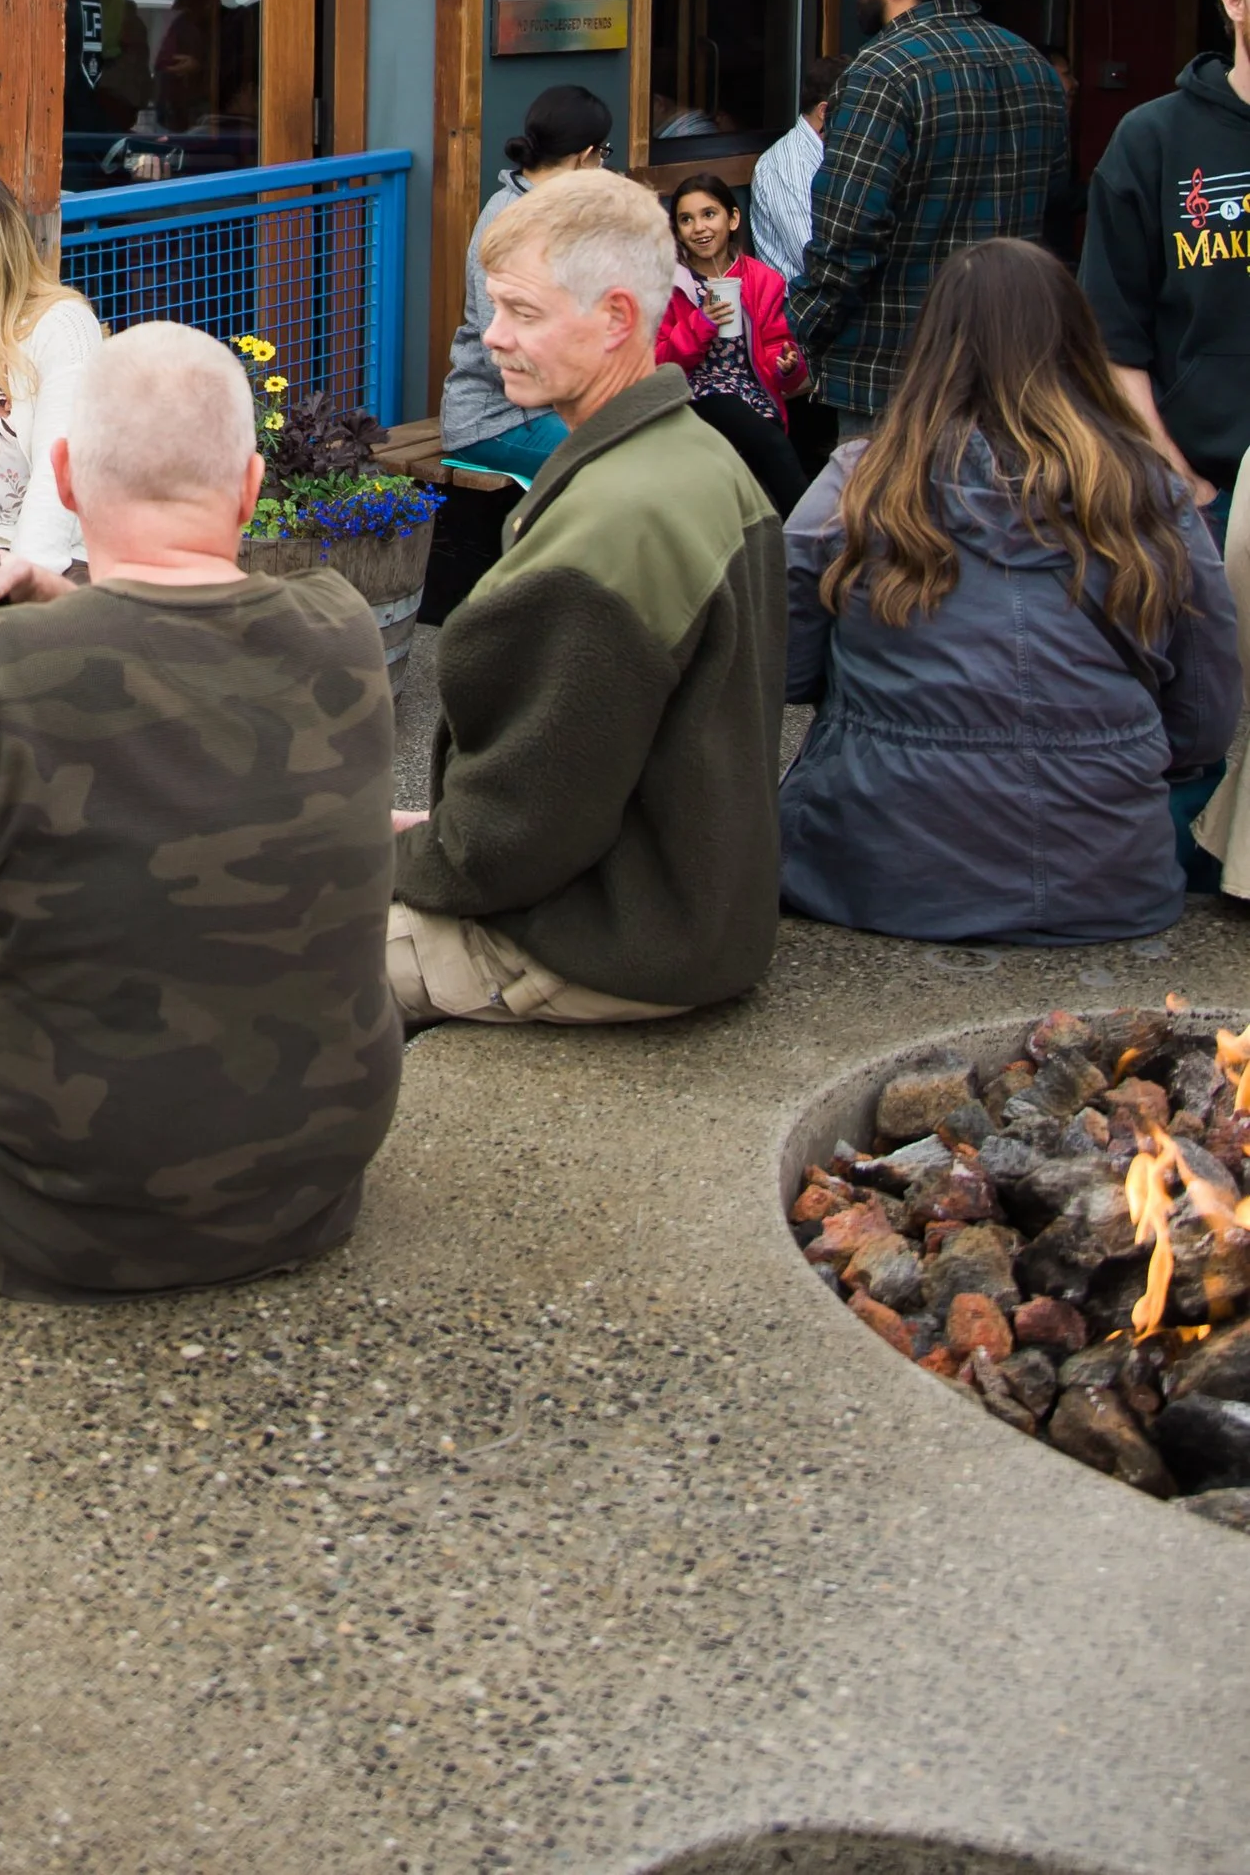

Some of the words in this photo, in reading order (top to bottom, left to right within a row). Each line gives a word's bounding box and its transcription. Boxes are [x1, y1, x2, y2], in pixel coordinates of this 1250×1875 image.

[517, 20, 527, 32] NO
[530, 17, 581, 32] FOUR-LEGGED
[583, 16, 612, 30] FRIENDS
[1173, 229, 1250, 269] MAK
